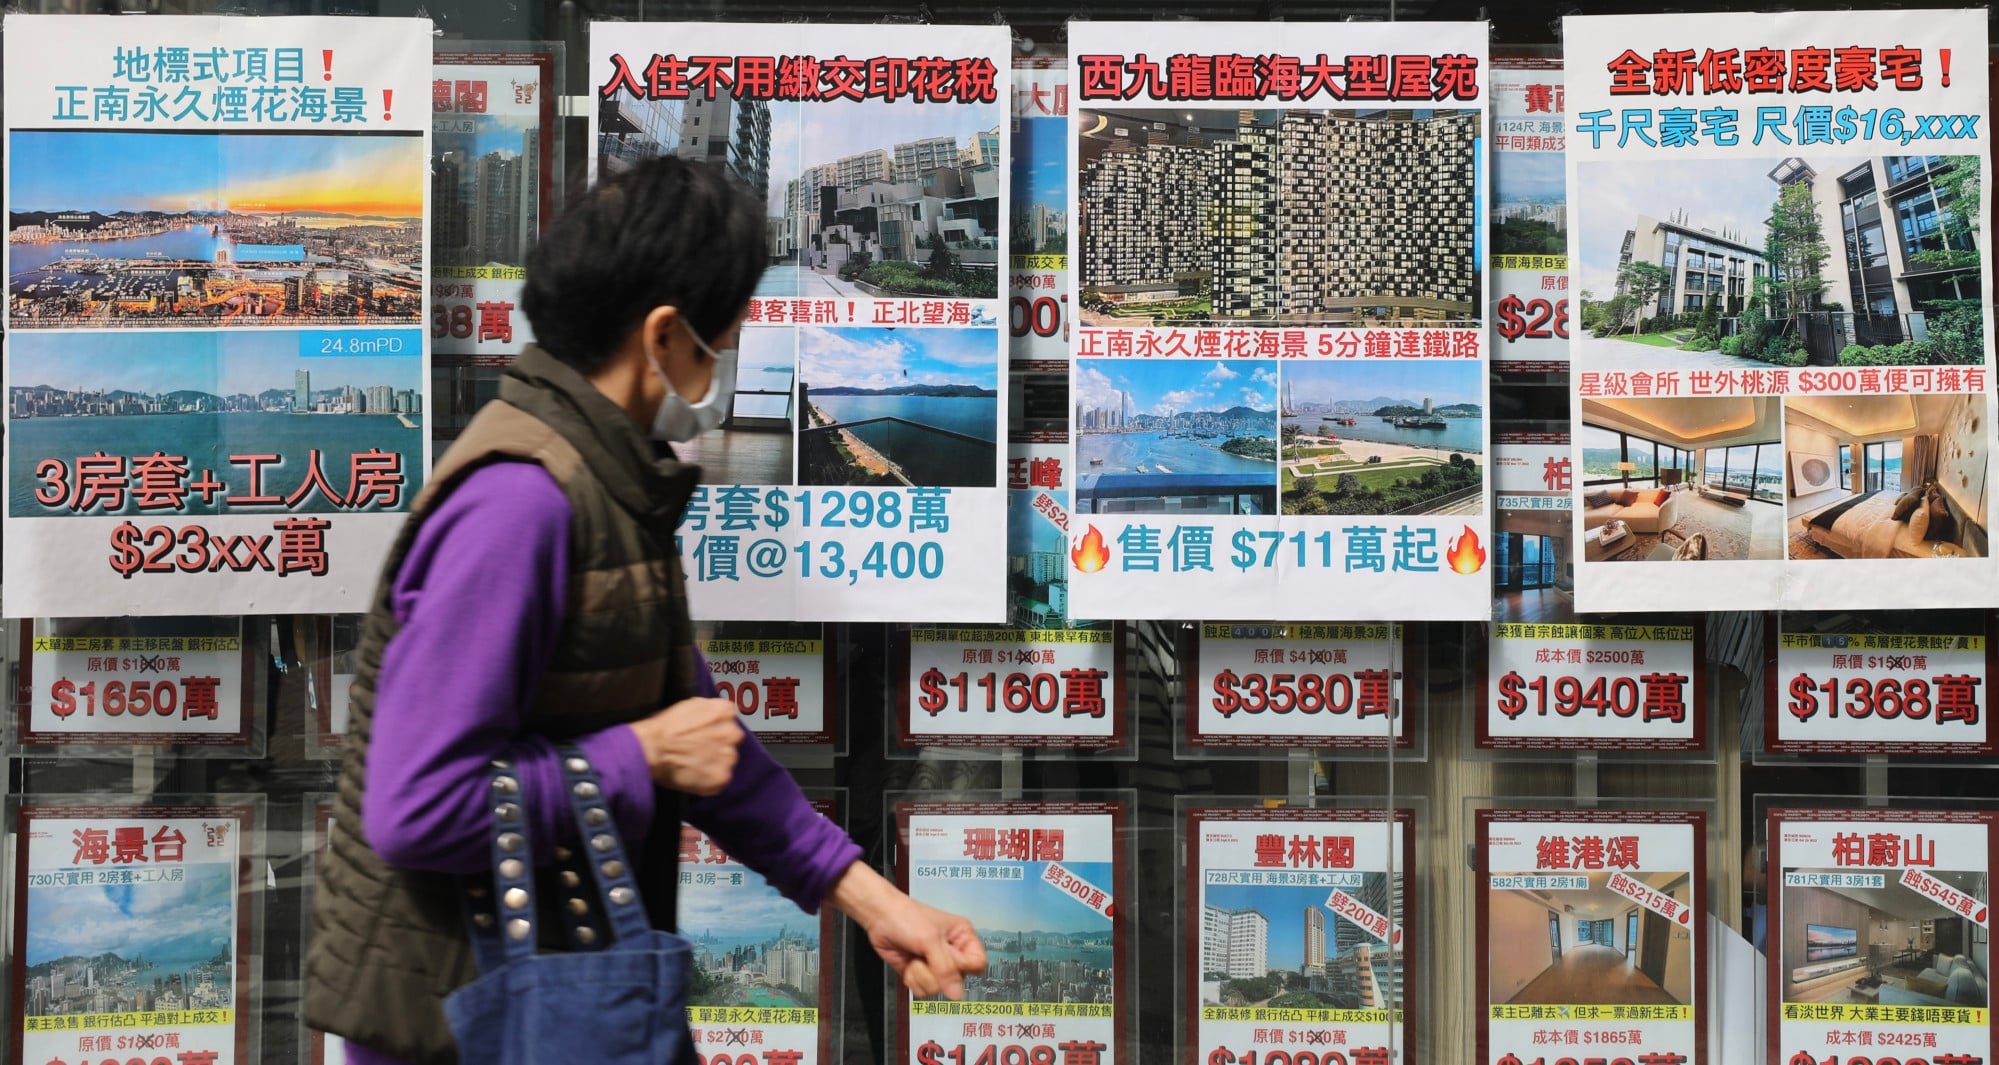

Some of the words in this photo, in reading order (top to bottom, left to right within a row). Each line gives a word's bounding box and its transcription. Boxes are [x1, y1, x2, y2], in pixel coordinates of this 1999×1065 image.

[602, 54, 998, 104] 入住不用繳交印花稅
[1078, 54, 1479, 101] 西九龍臨海大型屋苑
[1607, 45, 1952, 95] 全新低密度豪宅！
[1539, 121, 1565, 133] 海景
[1576, 107, 1739, 149] 千尺豪宅
[1752, 105, 1980, 148] 尺價$16,xxx
[1010, 256, 1054, 269] 層成交
[872, 300, 971, 325] 正北望海
[1009, 295, 1069, 338] 00
[321, 337, 403, 353] 24.8mPD
[1077, 329, 1308, 358] 正南永久煙花海景
[1318, 331, 1480, 358] 5分鐘達鐵路
[1579, 370, 1680, 397] 星級會所
[1689, 369, 1790, 394] 世外桃源
[1798, 367, 1986, 393] $300萬便可擁有
[35, 449, 404, 512] 3房套+工人房
[1499, 497, 1553, 509] 735尺實用
[109, 517, 332, 579] $23xx萬
[1117, 524, 1214, 573] 售價
[1231, 525, 1440, 573] $711萬起
[675, 535, 945, 586] 價@13,400
[912, 630, 1026, 643] 平同類單位超過200萬
[1030, 631, 1112, 643] 東北景罕有放售
[1496, 624, 1606, 640] 榮獲首宗蝕讓個案
[1610, 626, 1693, 641] 高位入低位出
[35, 638, 114, 651] 大單邊三房套
[119, 638, 183, 651] 業主移民盤
[188, 638, 240, 651] 銀行估凸
[707, 641, 754, 653] 品味裝修
[87, 656, 119, 672] 原價
[962, 648, 993, 664] 原價
[1254, 648, 1285, 664] 原價
[1535, 648, 1582, 664] 成本價
[1587, 650, 1645, 665] $2500萬
[1832, 654, 1863, 669] 原價
[51, 676, 221, 721] $1650萬
[919, 667, 1109, 718] $1160萬
[1212, 669, 1402, 720] $3580萬
[1498, 670, 1689, 723] $1940萬
[1788, 672, 1982, 725] $1368萬
[71, 825, 187, 866] 海景台
[963, 828, 1065, 861] 珊瑚閣
[1254, 834, 1355, 868] 豐林閣
[1536, 835, 1640, 870] 維港頌
[1832, 832, 1935, 868] 柏蔚山
[29, 871, 94, 887] 730尺實用
[99, 868, 185, 884] 2房套+工人房
[696, 872, 744, 886] 3房一套
[917, 866, 972, 879] 654尺實用
[976, 866, 1022, 879] 海景樓皇
[1208, 872, 1262, 884] 728尺實用
[1266, 872, 1362, 887] 海景3房套+工人房
[1787, 873, 1842, 887] 781尺實用
[1846, 874, 1883, 888] 3房1套
[1044, 863, 1106, 910] 劈300萬
[1492, 876, 1547, 889] 582尺實用
[1610, 873, 1680, 918] 蝕$215萬
[1902, 868, 1976, 917] 蝕$545萬
[1328, 891, 1390, 938] 劈200萬
[699, 1007, 816, 1024] 單邊永久煙花海景
[912, 1003, 1023, 1016] 平過同層成交$200萬
[1028, 1004, 1113, 1018] 極罕有高層放售
[1204, 1008, 1251, 1021] 全新裝修
[1255, 1009, 1303, 1022] 銀行估凸
[1784, 1005, 1845, 1021] 看淡世界
[26, 1015, 79, 1031] 業主急售
[83, 1014, 136, 1029] 銀行估凸
[962, 1022, 993, 1038] 原價
[79, 1034, 112, 1052] 原價
[1253, 1028, 1284, 1044] 原價
[1533, 1029, 1579, 1045] 成本價
[1584, 1029, 1642, 1045] $1865萬
[1826, 1030, 1873, 1045] 成本價
[1878, 1032, 1938, 1048] $2425萬
